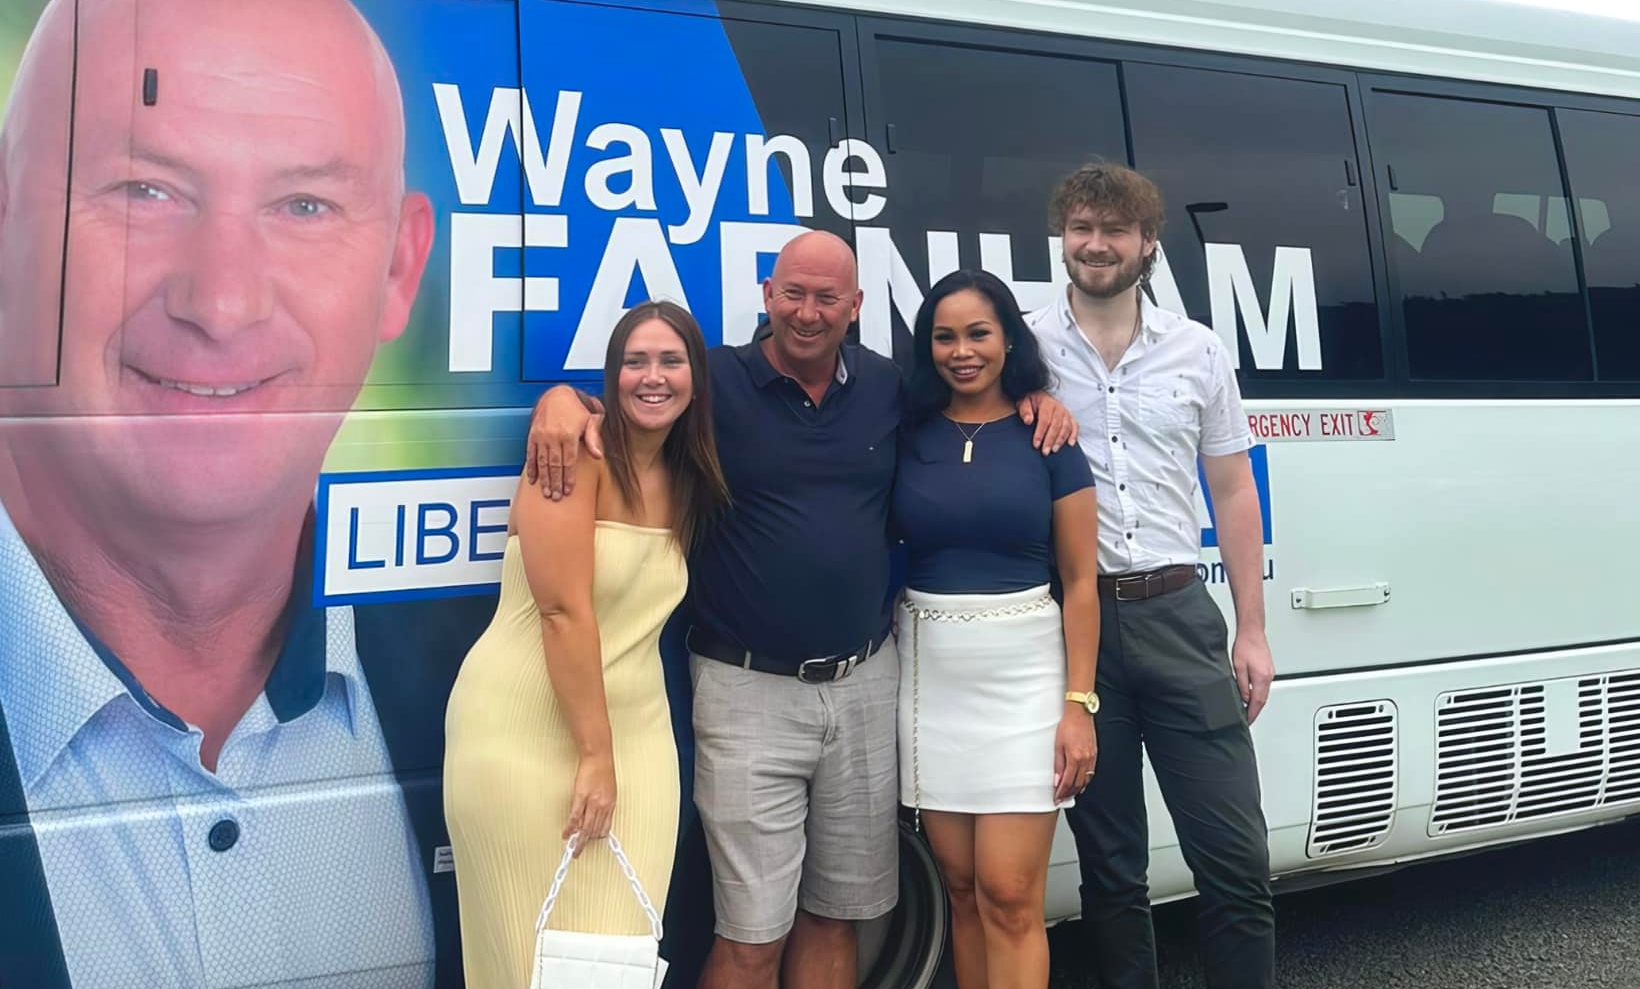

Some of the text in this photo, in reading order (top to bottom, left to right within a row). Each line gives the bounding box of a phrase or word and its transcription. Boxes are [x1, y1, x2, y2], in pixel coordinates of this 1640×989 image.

[432, 82, 889, 245] Wayne
[448, 212, 1323, 374] FANM
[1320, 413, 1354, 437] EXIT
